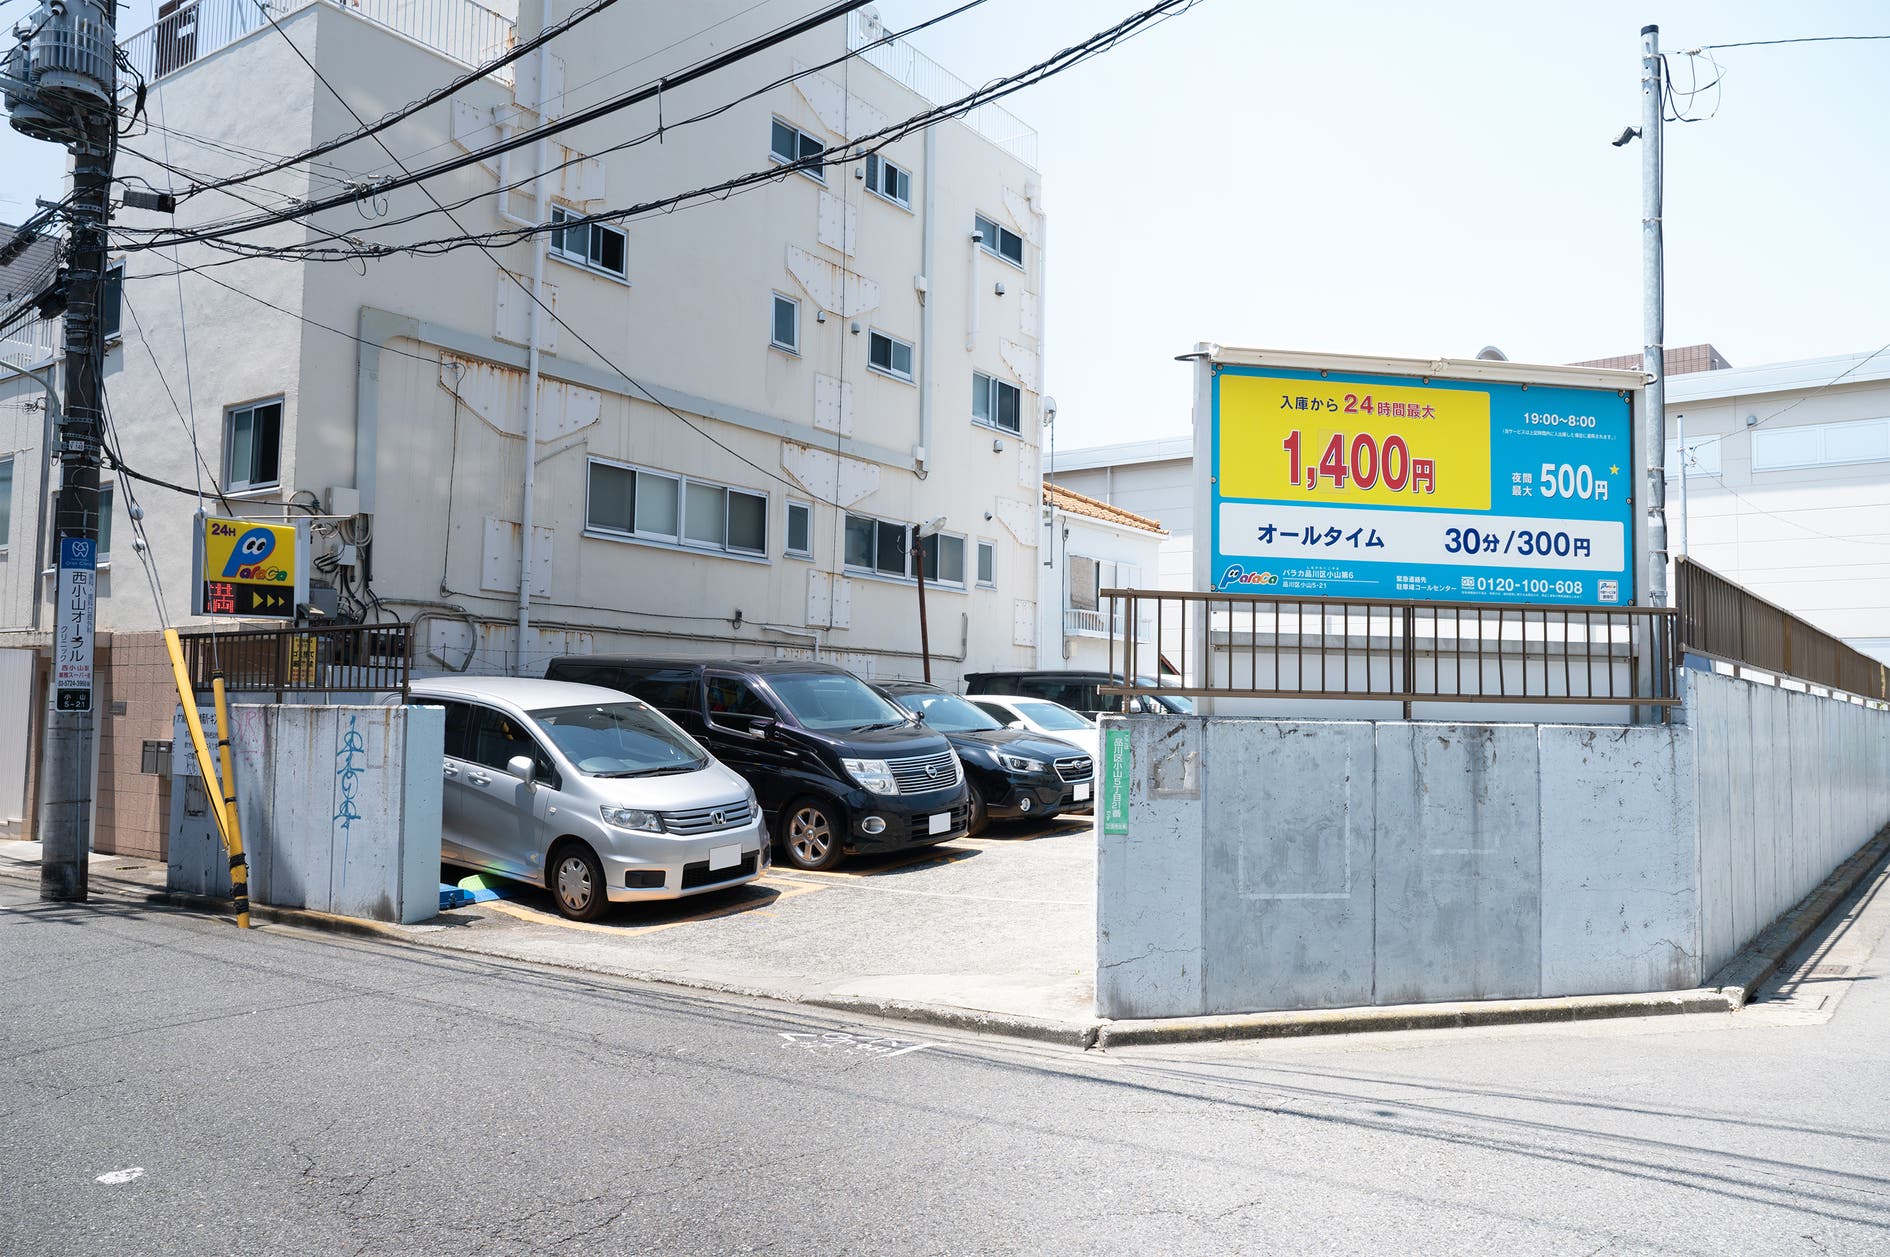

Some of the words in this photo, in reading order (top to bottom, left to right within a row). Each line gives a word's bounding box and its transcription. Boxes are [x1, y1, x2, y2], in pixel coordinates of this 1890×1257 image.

[1283, 429, 1436, 494] 1,400円
[1511, 472, 1533, 484] 夜間
[1511, 485, 1533, 497] 最大
[1540, 463, 1608, 501] 500円
[211, 523, 236, 537] 24H
[1257, 523, 1386, 549] オールタイム
[207, 583, 235, 614] 満
[1477, 577, 1583, 595] 0120-100-608
[69, 571, 87, 662] 西小山オーラル
[60, 625, 68, 662] クリニック
[1112, 738, 1123, 818] 品川区小山5丁目21番
